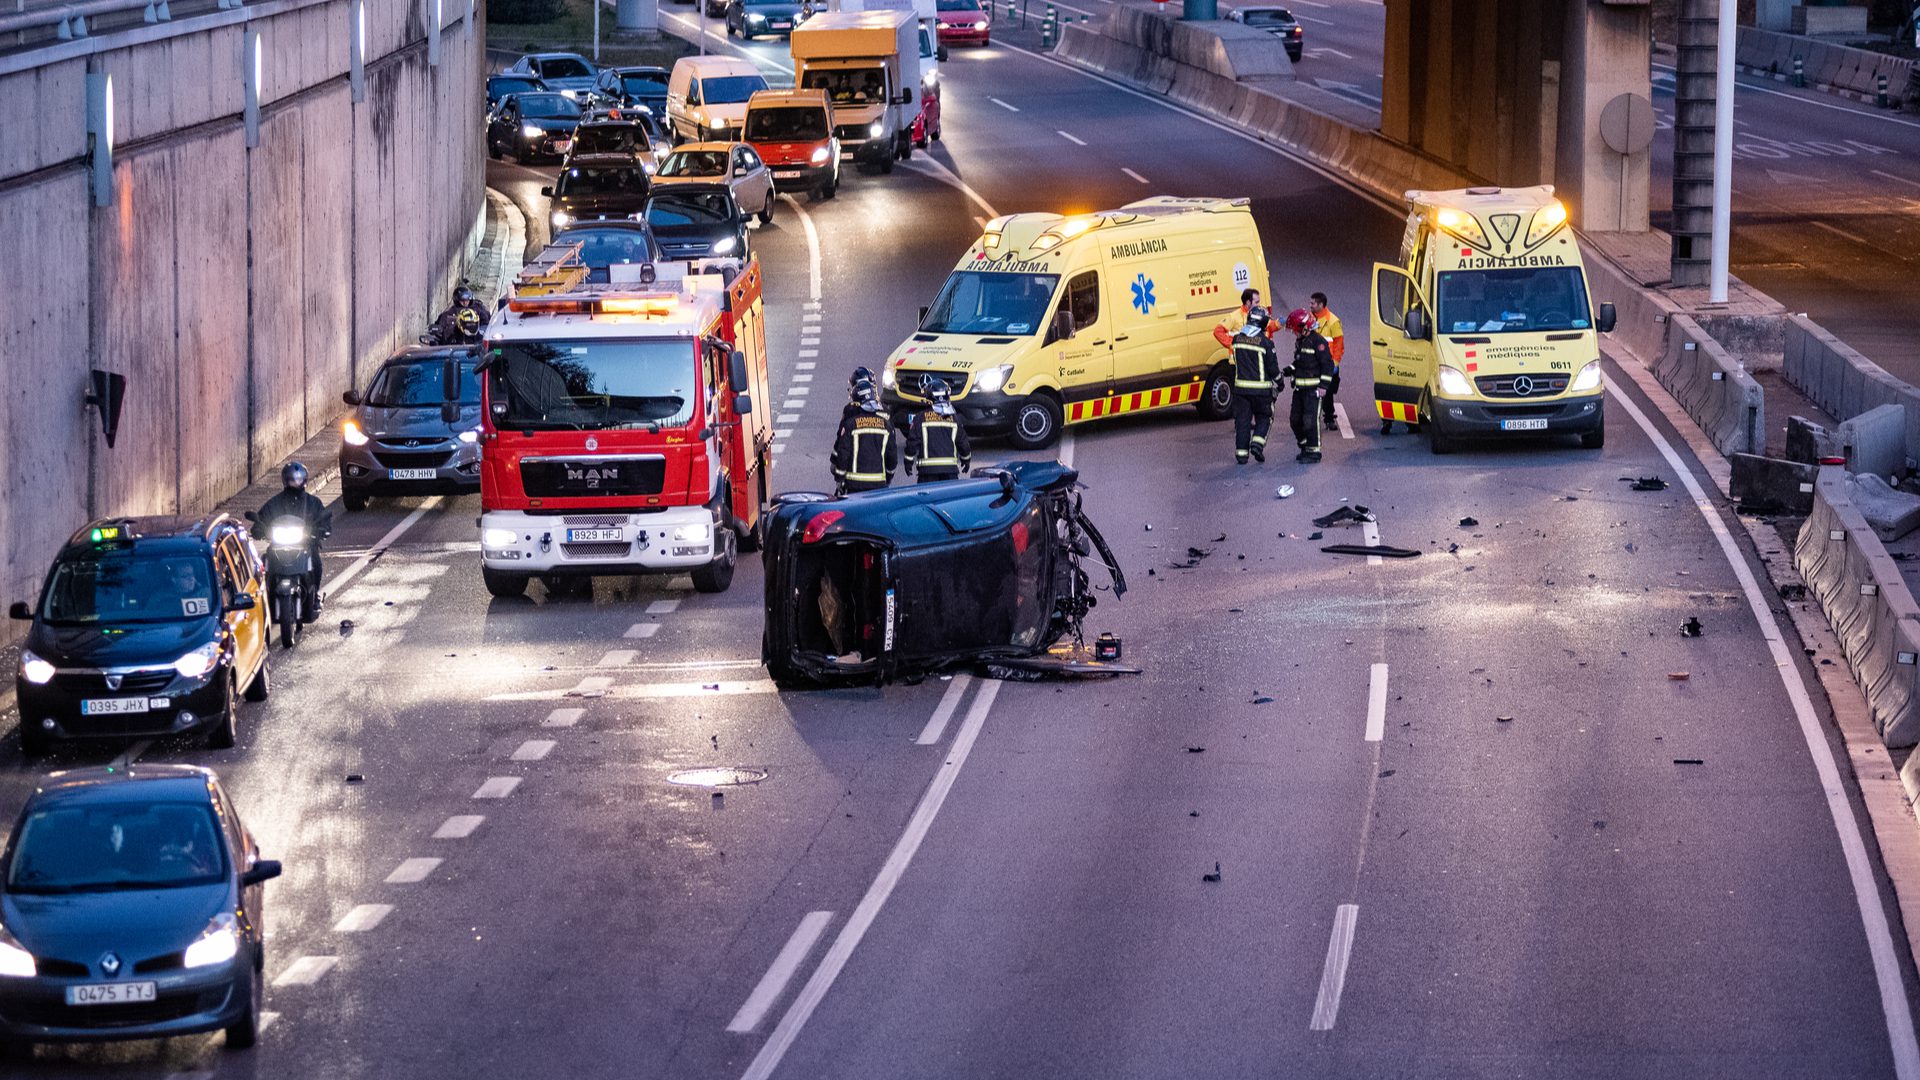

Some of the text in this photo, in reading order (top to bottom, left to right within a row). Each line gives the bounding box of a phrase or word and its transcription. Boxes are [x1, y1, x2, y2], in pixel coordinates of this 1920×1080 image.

[1111, 238, 1168, 260] AMBULÀNCIA
[1235, 269, 1248, 281] 112
[951, 360, 974, 369] 0737
[1550, 361, 1572, 370] 0611
[1506, 419, 1546, 430] 0896 HTR
[394, 470, 415, 479] 0478
[567, 468, 618, 479] MAN
[574, 530, 621, 540] 8929 HFJ
[90, 700, 144, 712] 0395 JHX
[79, 983, 154, 1001] 0475 FYJ
